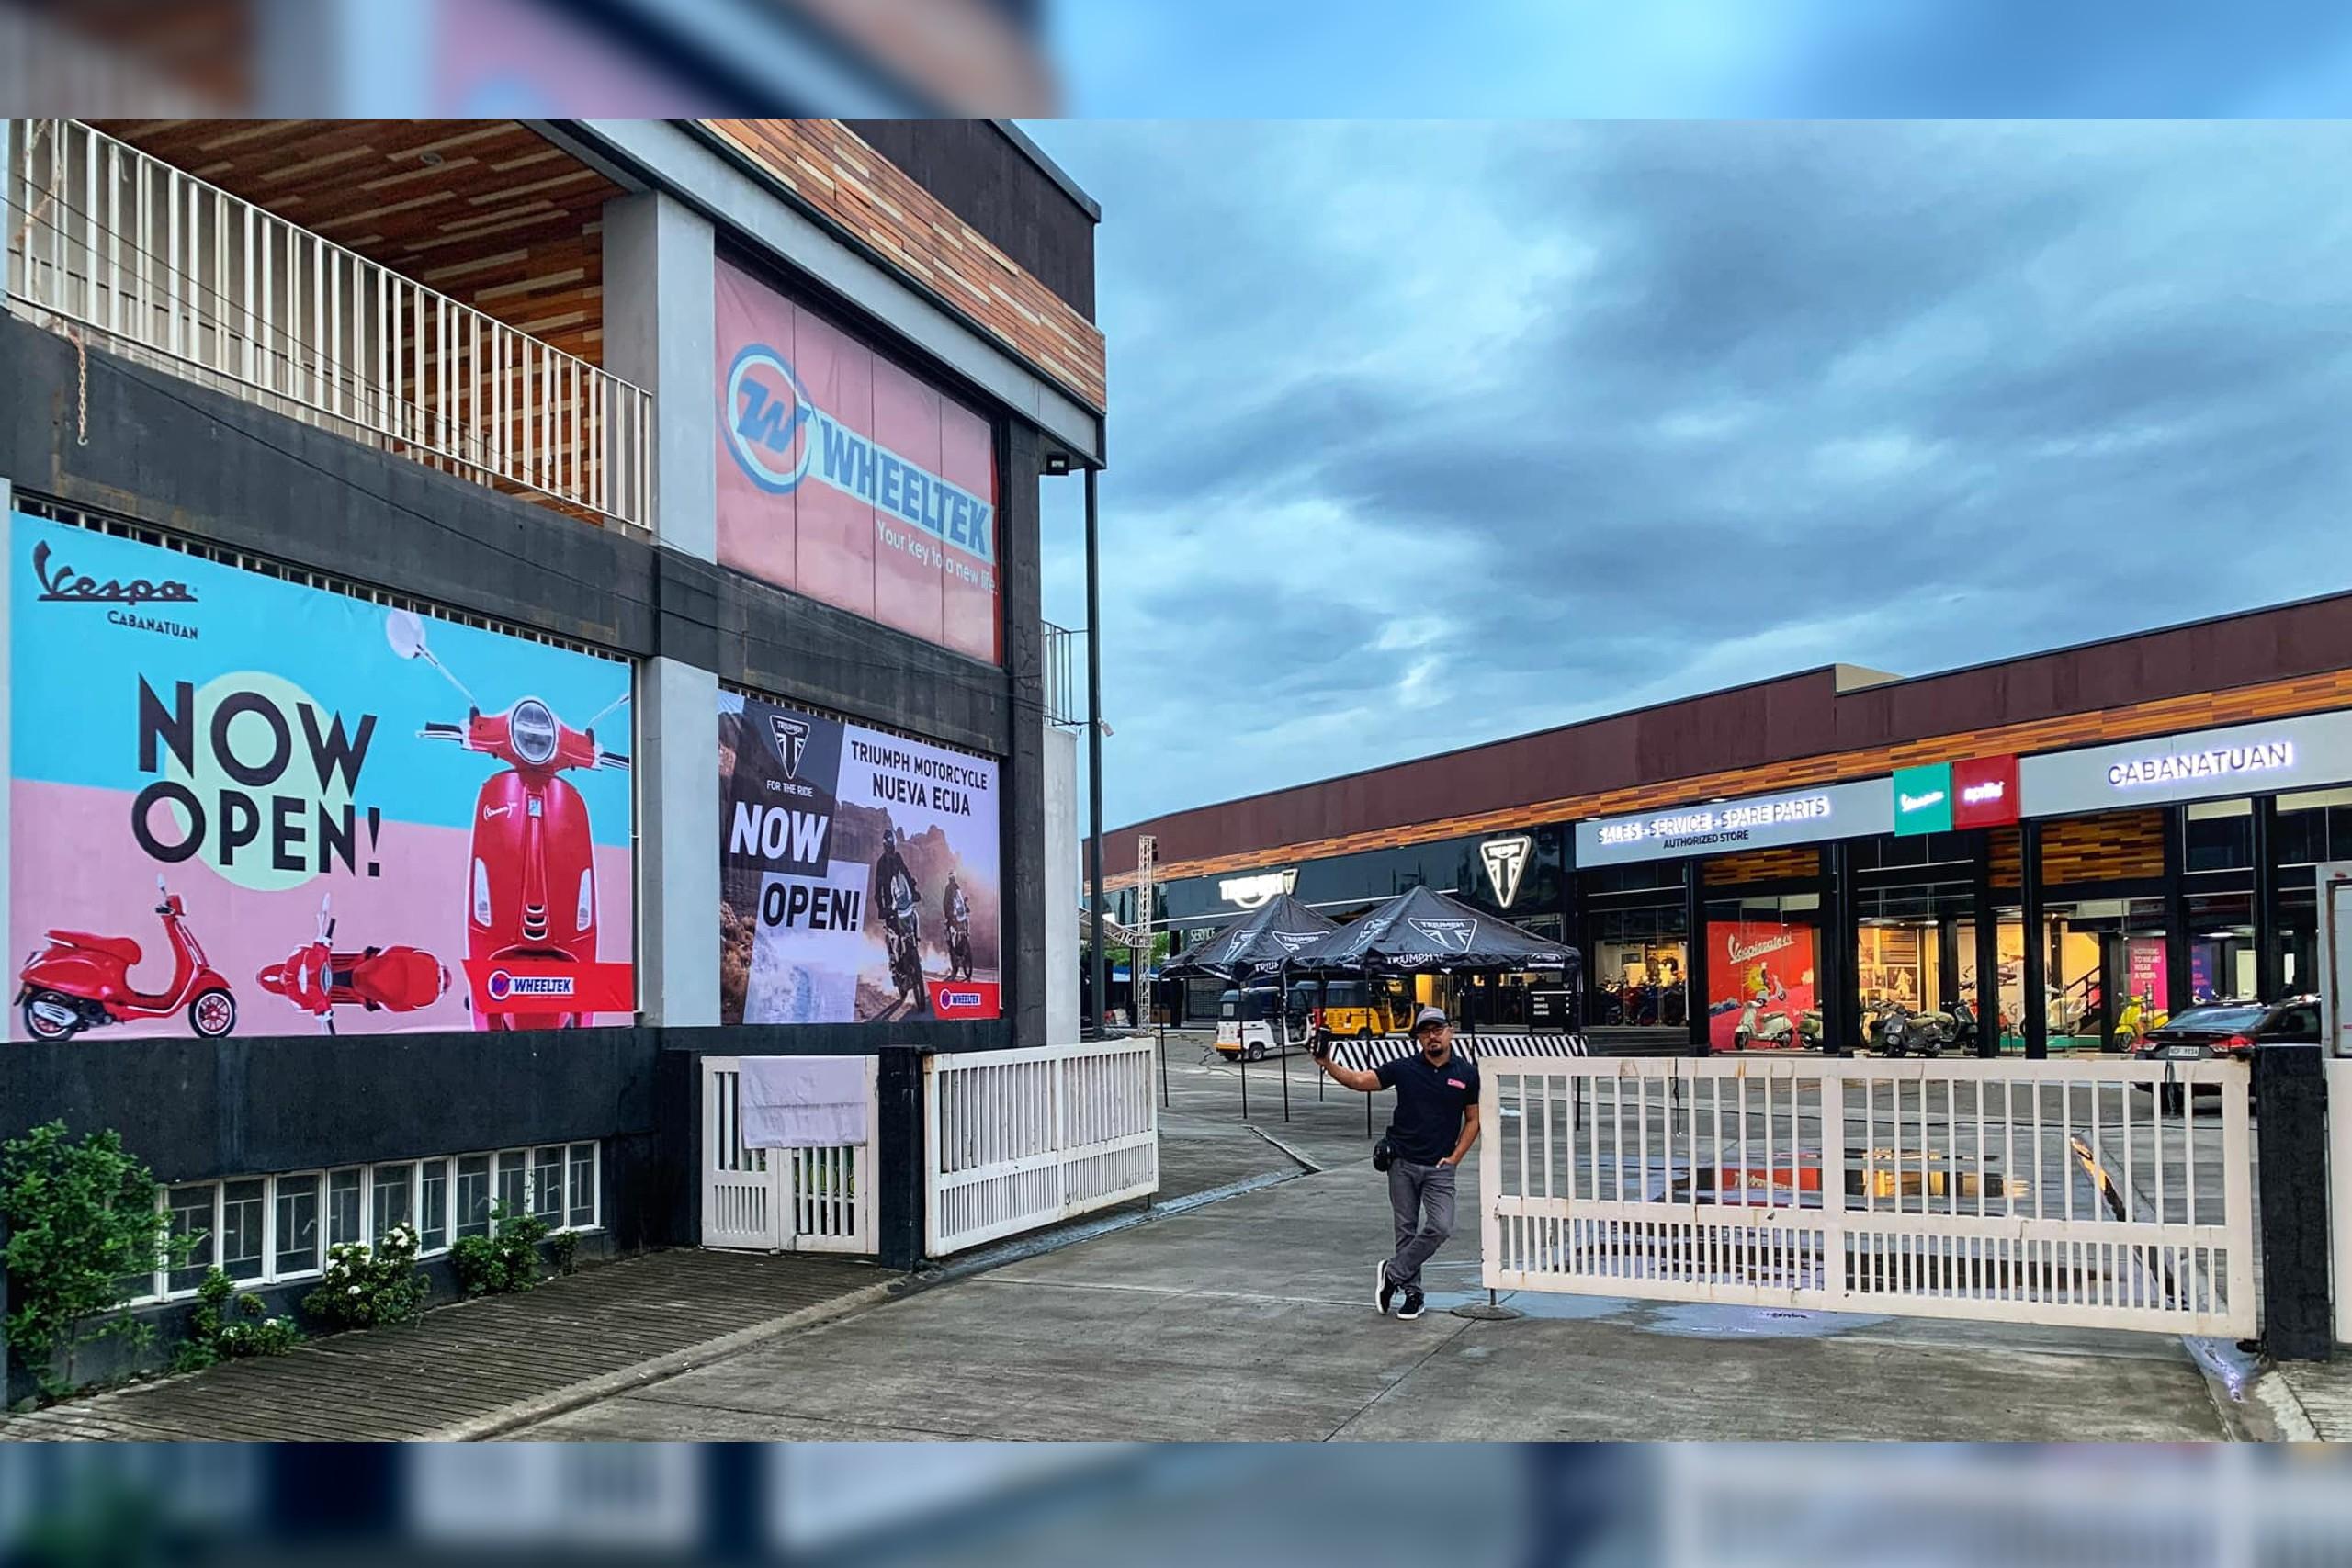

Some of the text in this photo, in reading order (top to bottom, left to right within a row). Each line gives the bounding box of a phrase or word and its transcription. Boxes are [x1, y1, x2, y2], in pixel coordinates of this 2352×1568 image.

[821, 418, 989, 556] WHEELTEK
[33, 540, 198, 605] Vespa
[877, 520, 905, 550] Your
[908, 534, 929, 566] key
[932, 546, 943, 568] to
[946, 558, 954, 573] a
[956, 562, 979, 587] new
[107, 610, 198, 640] CABANATUAN
[139, 672, 377, 798] NOW
[851, 740, 988, 790] TRIUMPH MOTORCYCLE
[2108, 743, 2288, 785] CABANATUAN
[766, 780, 814, 797] FOR THE RIDE
[872, 773, 971, 816] NUEVA ECIJA
[131, 781, 381, 878] OPEN!
[729, 801, 829, 863] NOW
[1598, 825, 1638, 843] SALES
[1649, 815, 1708, 837] SERVICE
[1721, 807, 1769, 828] SPARE
[1773, 798, 1826, 821] PARTS
[1663, 830, 1749, 849] AUTHORIZED STORE
[763, 882, 860, 931] OPEN!
[1386, 953, 1434, 967] TRIUMPH
[514, 979, 570, 992] WHEELTEK
